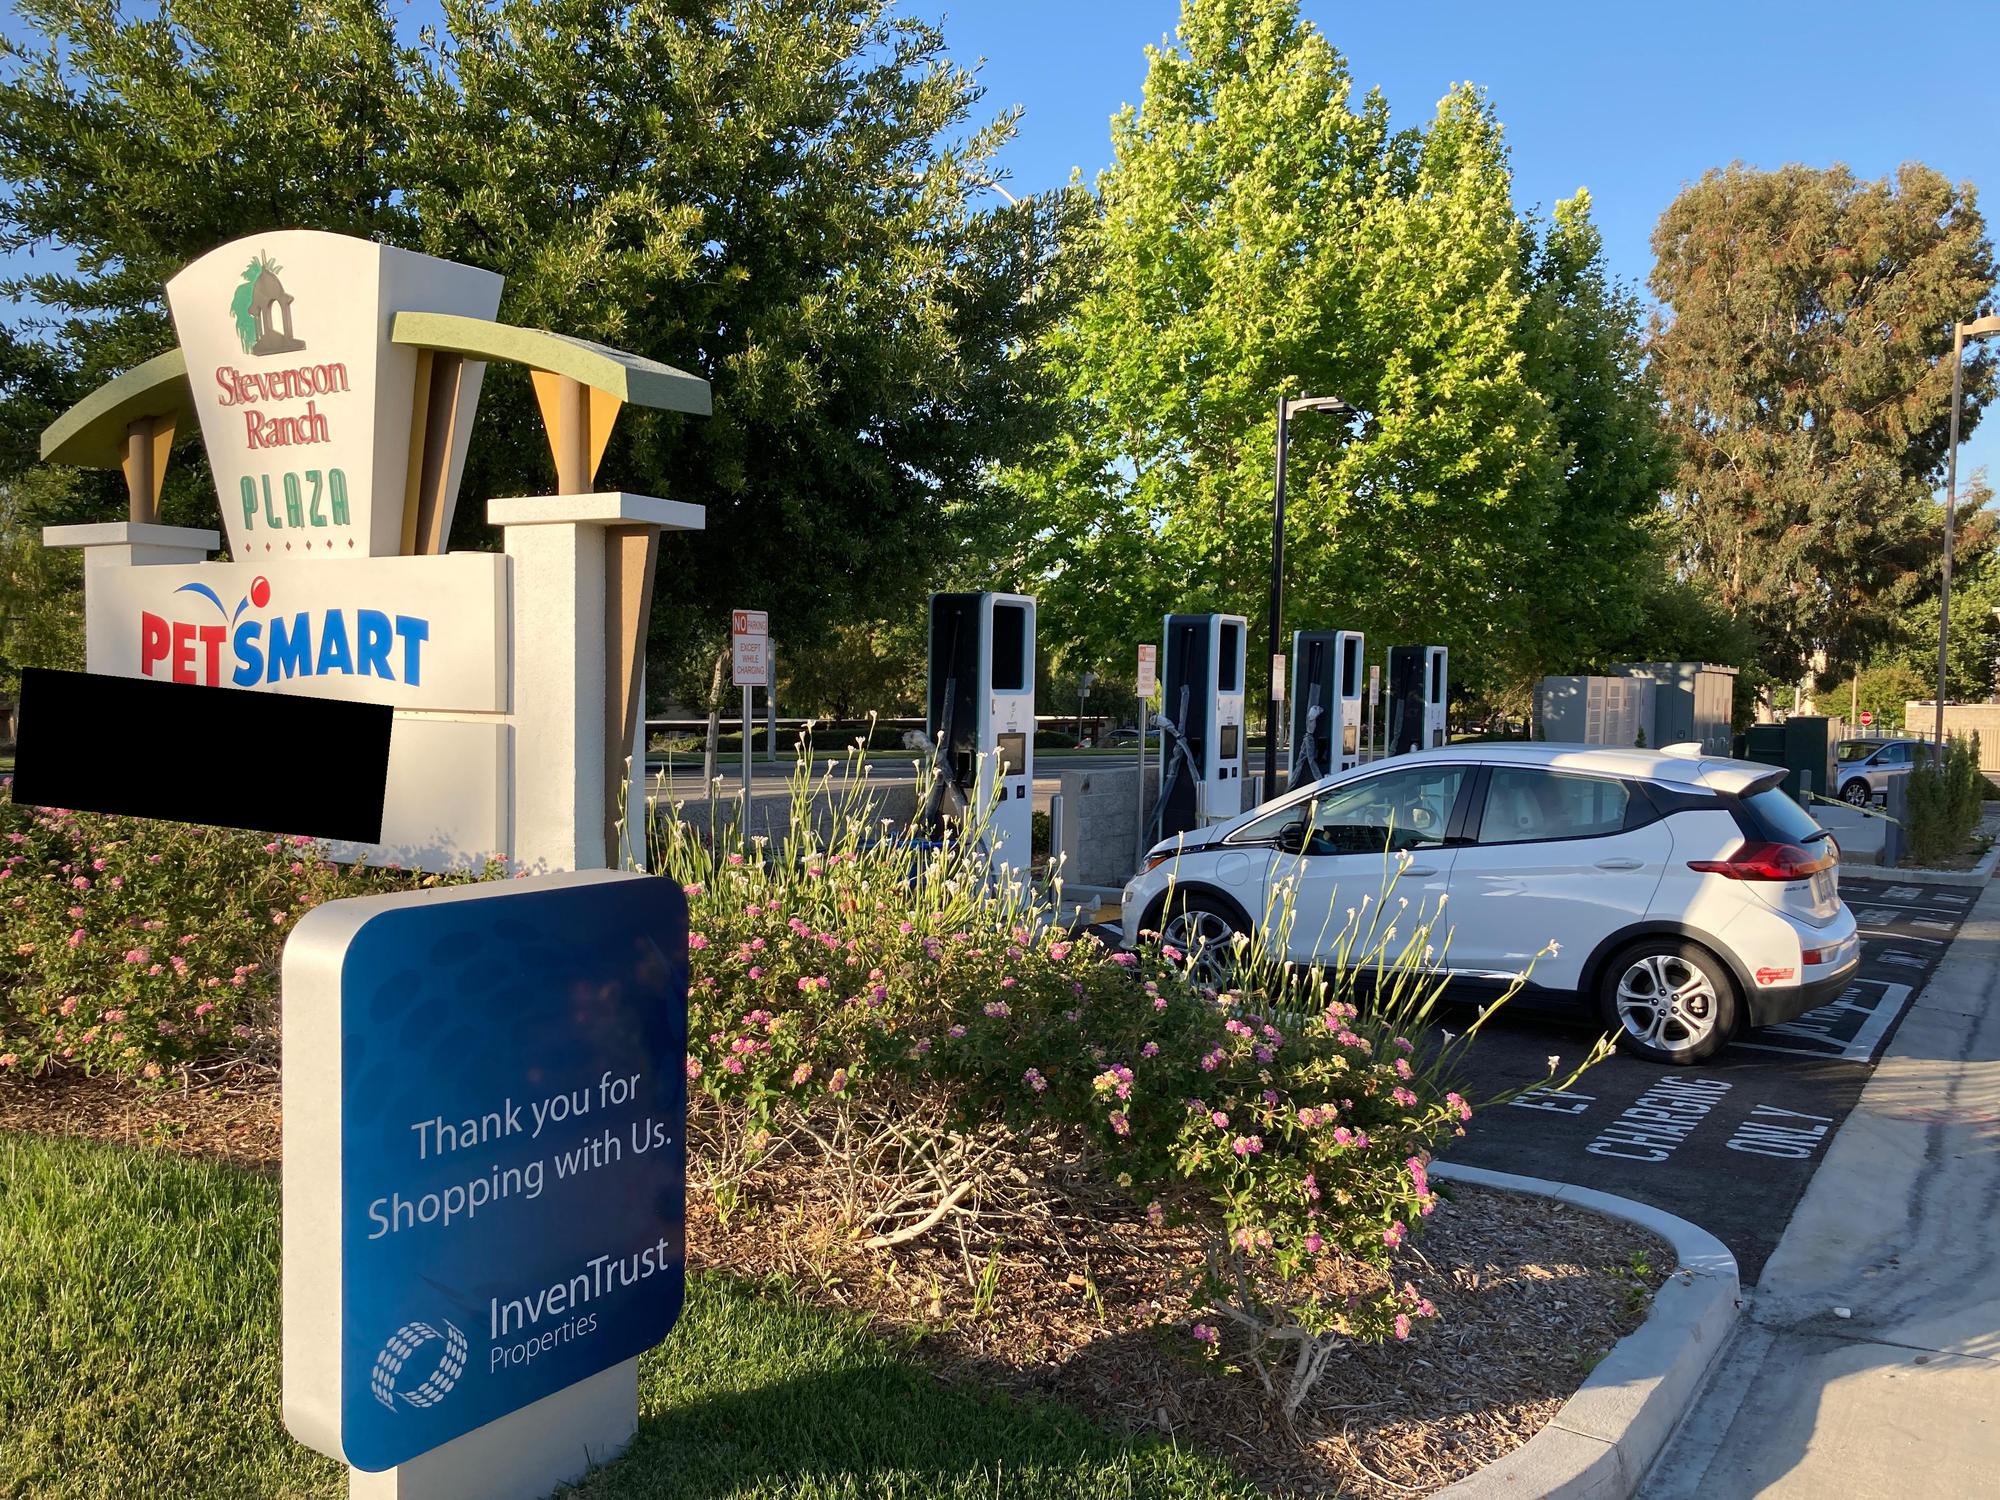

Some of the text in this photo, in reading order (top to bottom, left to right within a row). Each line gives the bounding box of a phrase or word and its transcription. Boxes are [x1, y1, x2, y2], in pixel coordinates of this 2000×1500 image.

[215, 362, 351, 406] Stevenson
[243, 400, 331, 449] Ranch
[240, 468, 351, 531] PLAZA
[734, 615, 747, 632] NO
[740, 642, 761, 652] EXCEPT
[736, 665, 765, 675] CHARGING
[742, 654, 760, 664] WHILE
[410, 1070, 642, 1160] Thank you for
[1585, 1076, 1733, 1162] CHARGING
[1726, 1104, 1834, 1159] ONLY
[367, 1118, 673, 1240] Shopping with Us.
[490, 1237, 670, 1341] InvenTrust
[490, 1312, 598, 1375] Properties
